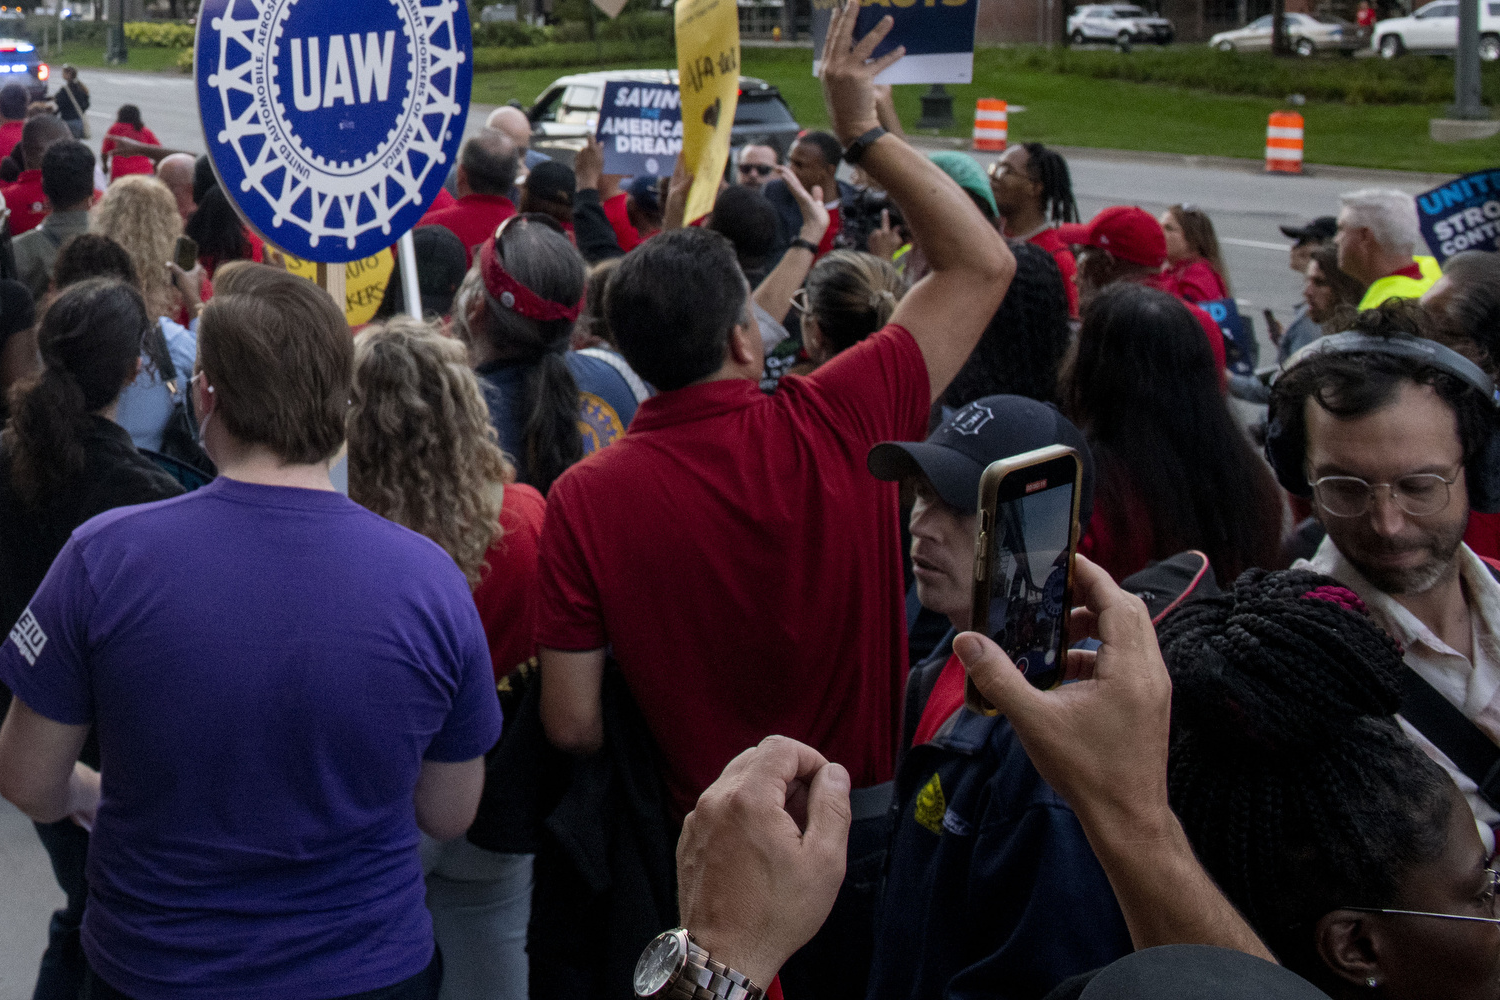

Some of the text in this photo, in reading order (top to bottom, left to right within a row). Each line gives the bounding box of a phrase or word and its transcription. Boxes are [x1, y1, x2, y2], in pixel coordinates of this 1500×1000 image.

[290, 30, 396, 112] UAW
[416, 33, 428, 98] WORKERS
[255, 51, 282, 143] AUTOMOBILE,
[414, 101, 422, 119] OF
[613, 86, 682, 110] SAVIN
[278, 144, 311, 180] UNITED
[381, 123, 414, 170] AMERICA
[615, 134, 683, 156] DREAM
